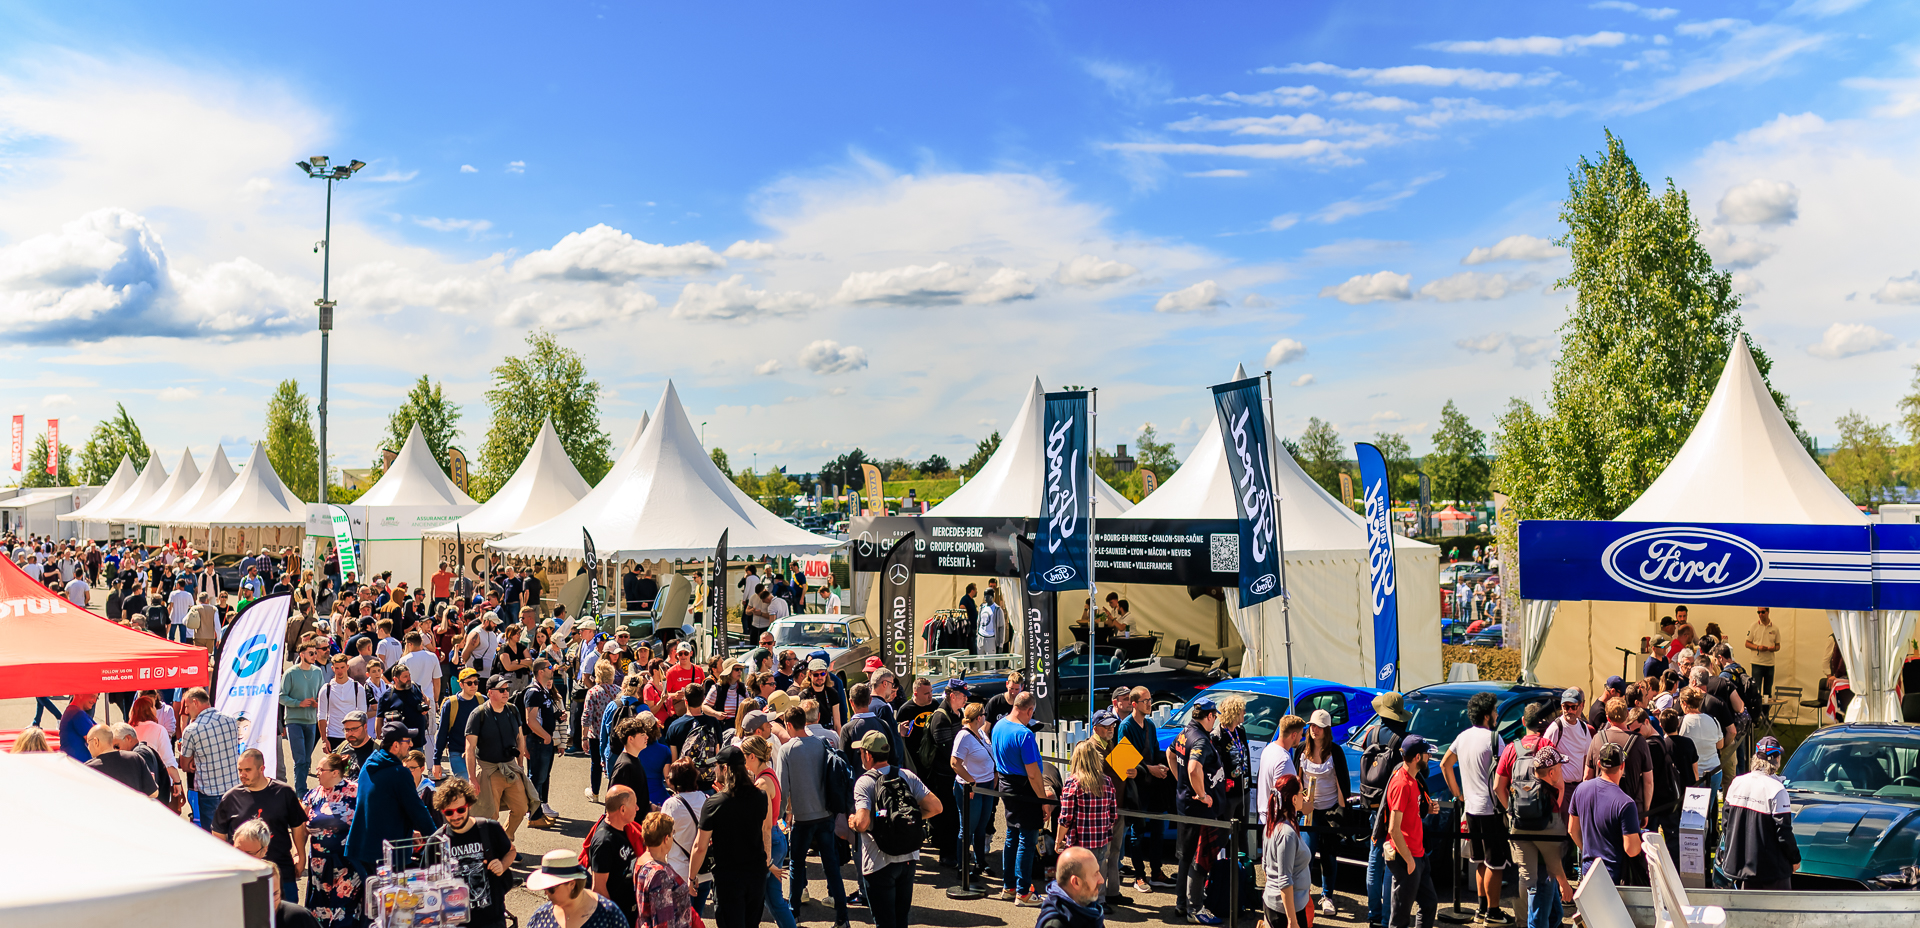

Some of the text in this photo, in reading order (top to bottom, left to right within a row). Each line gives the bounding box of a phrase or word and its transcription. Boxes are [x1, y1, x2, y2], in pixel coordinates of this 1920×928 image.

[932, 526, 984, 538] MERCEDES-BENZ
[1103, 533, 1148, 542] BOURG-EN-BRESSE
[1151, 533, 1204, 543] CHALON-SUR-SAÔNE
[441, 542, 456, 555] 19
[881, 538, 926, 551] CHRD
[929, 541, 985, 553] GROUPE CHOPARD
[1089, 546, 1192, 557] S-LE-SAUNIER LYON MÂCON NEVERS
[938, 554, 966, 567] PRÉSENT
[1113, 561, 1132, 569] VIENNE
[1135, 561, 1173, 570] VILLEFRANCHE
[1639, 539, 1732, 584] Ford
[804, 560, 829, 577] AUTO
[893, 596, 907, 677] CHOPARD
[229, 683, 273, 697] GETRAC
[451, 842, 484, 857] ONARD
